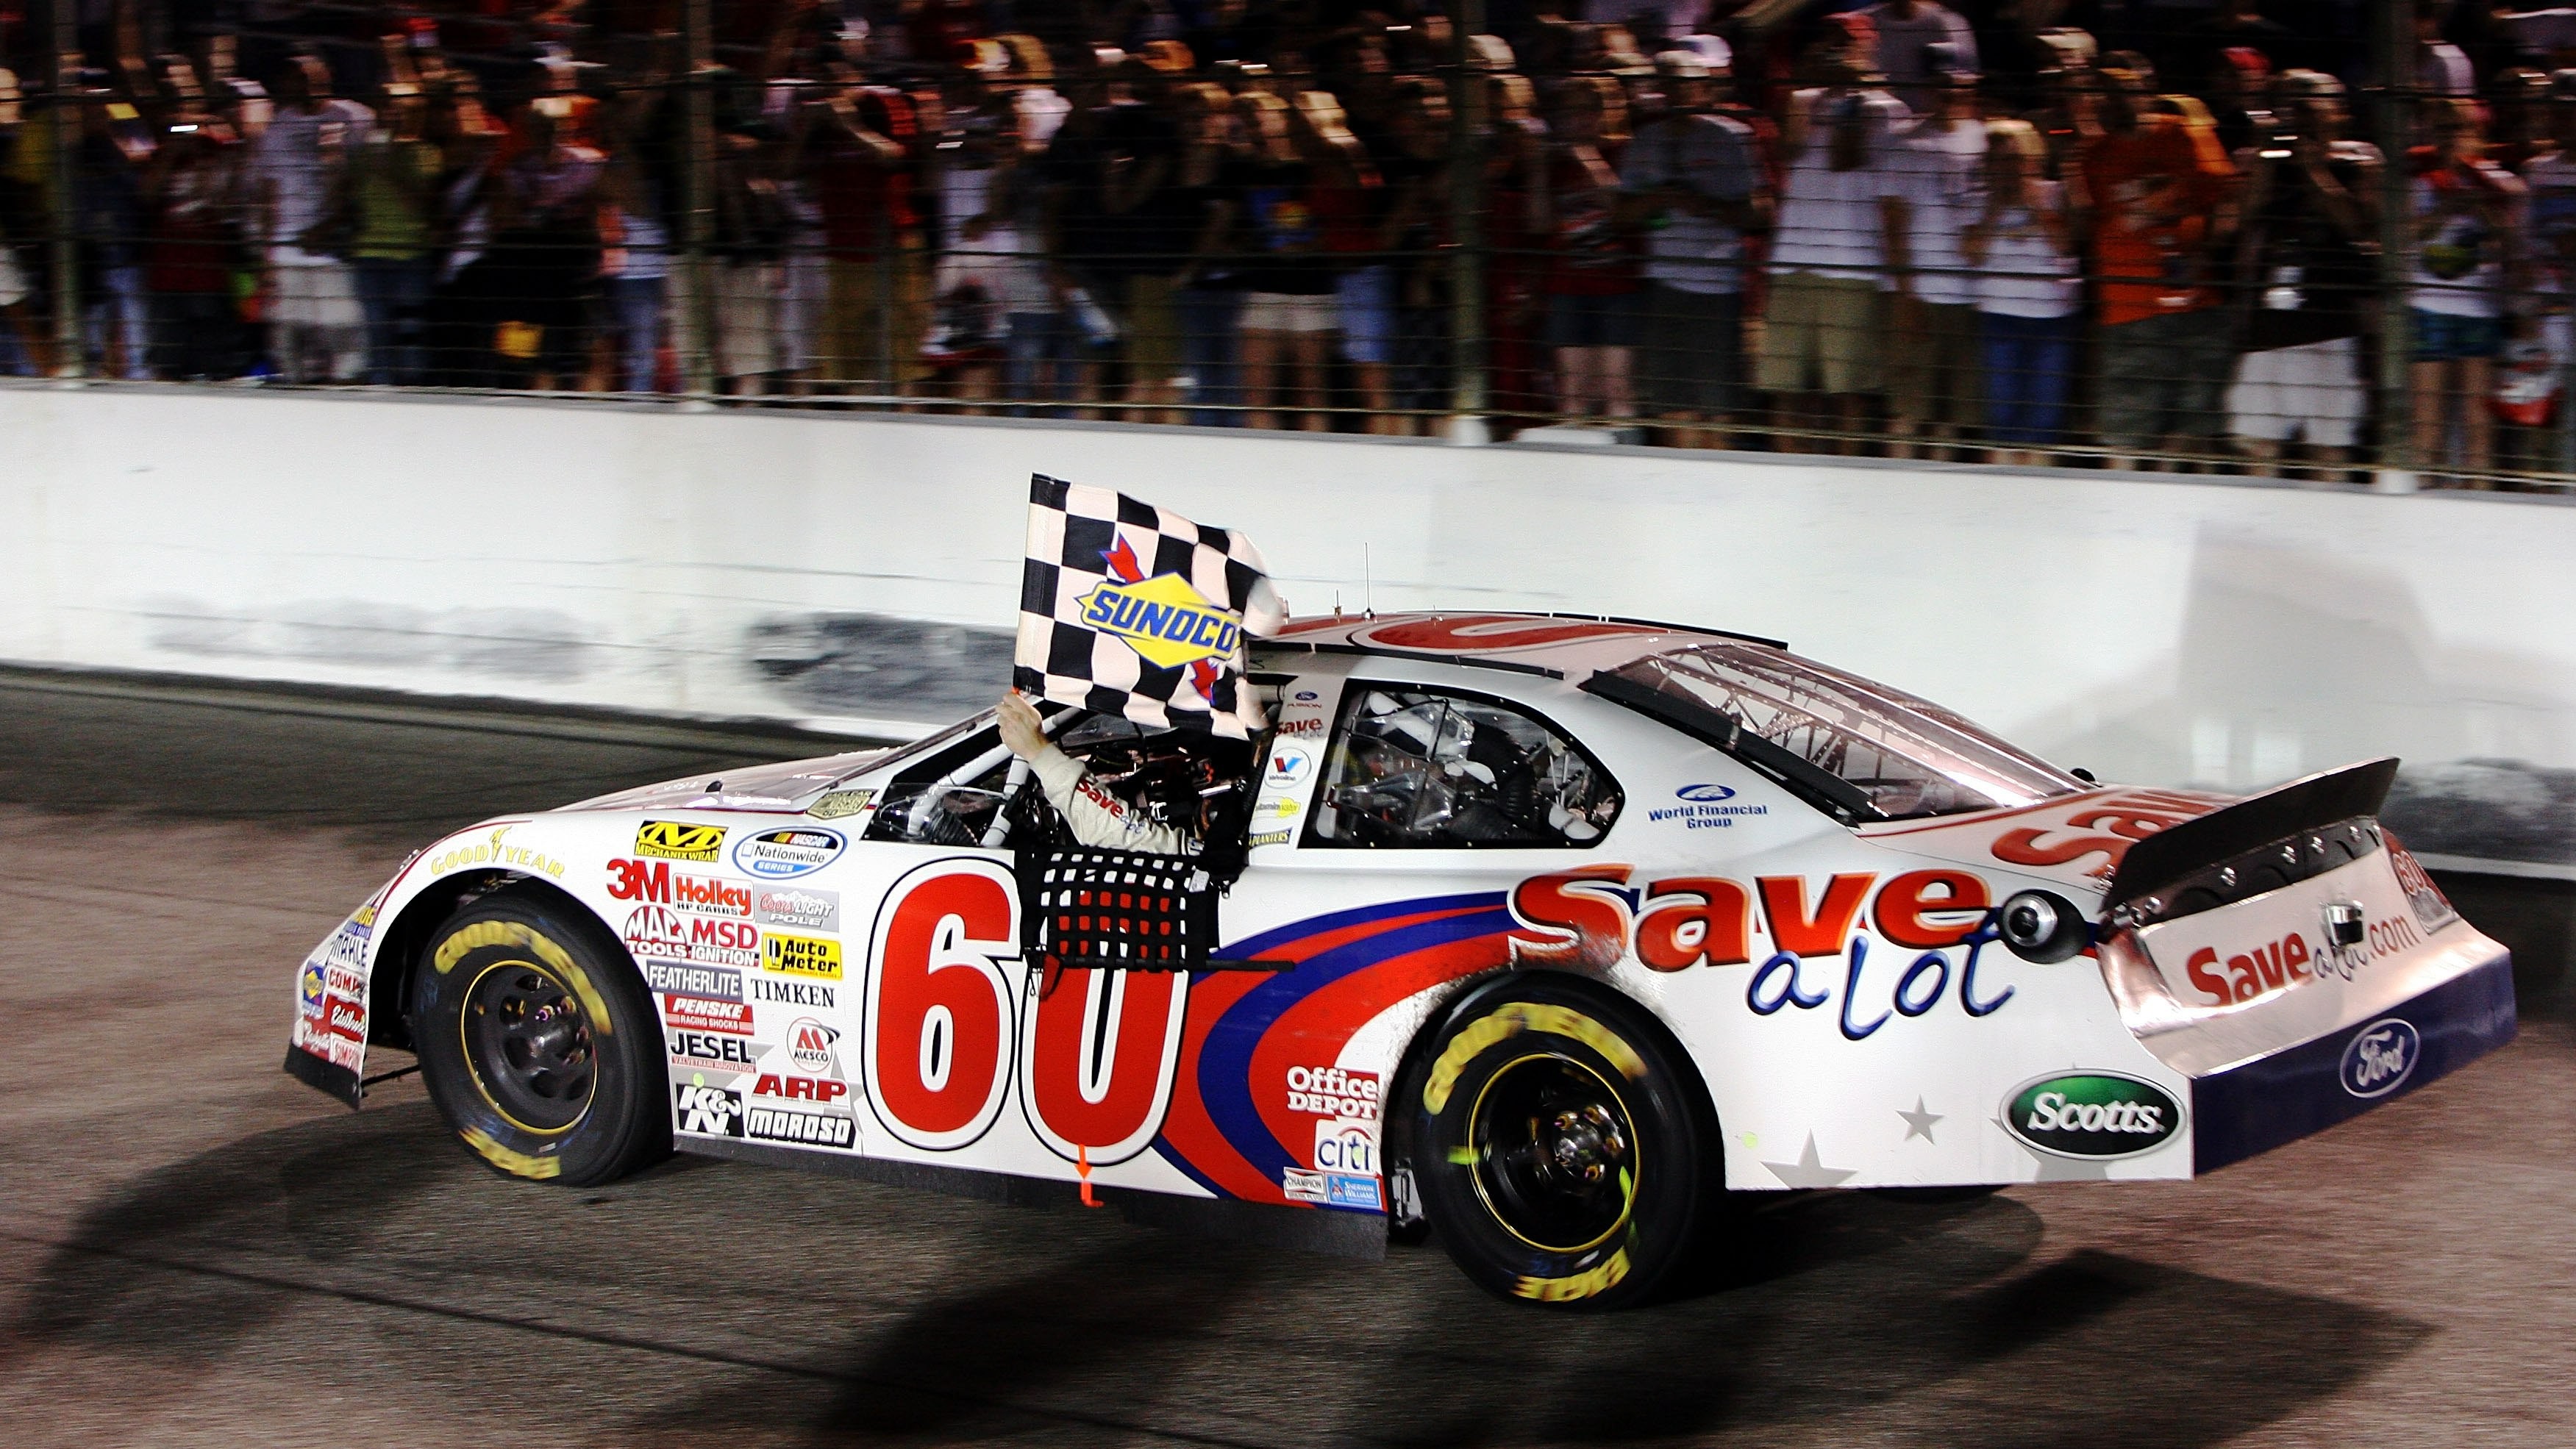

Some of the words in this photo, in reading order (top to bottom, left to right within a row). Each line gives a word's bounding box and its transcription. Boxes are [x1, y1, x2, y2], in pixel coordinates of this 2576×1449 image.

[1086, 589, 1238, 654] SUNOCO
[1075, 779, 1124, 818] Save
[1648, 806, 1694, 821] World
[1697, 804, 1768, 816] Financial
[1686, 817, 1733, 829] Group
[754, 844, 825, 864] Nationwide
[791, 833, 830, 848] NASCAR
[607, 858, 671, 904] 3M
[674, 875, 752, 916] Holley
[760, 892, 795, 912] Coors
[794, 900, 835, 917] LIGHT
[1511, 862, 1994, 973] Save
[629, 906, 682, 942] MAC
[692, 919, 758, 949] MSD
[768, 913, 824, 928] POLE
[626, 939, 688, 959] TOOLS
[690, 946, 756, 966] IGNITION
[785, 939, 827, 956] Auto
[780, 954, 838, 973] Meter
[649, 964, 742, 997] FEATHERLITE
[751, 978, 835, 1008] TIMKEN
[673, 997, 744, 1020] PENSKE
[680, 1015, 707, 1027] RACING
[708, 1017, 739, 1031] SHOCKS
[869, 866, 1182, 1156] 60
[670, 1031, 752, 1064] JESEL
[2355, 1029, 2407, 1089] Ford
[752, 1073, 847, 1103] ARP
[1288, 1066, 1379, 1100] Office
[1288, 1091, 1377, 1120] DEPOT
[2028, 1091, 2162, 1135] Scotts
[749, 1109, 852, 1145] MOROSO
[1318, 1134, 1370, 1170] citi
